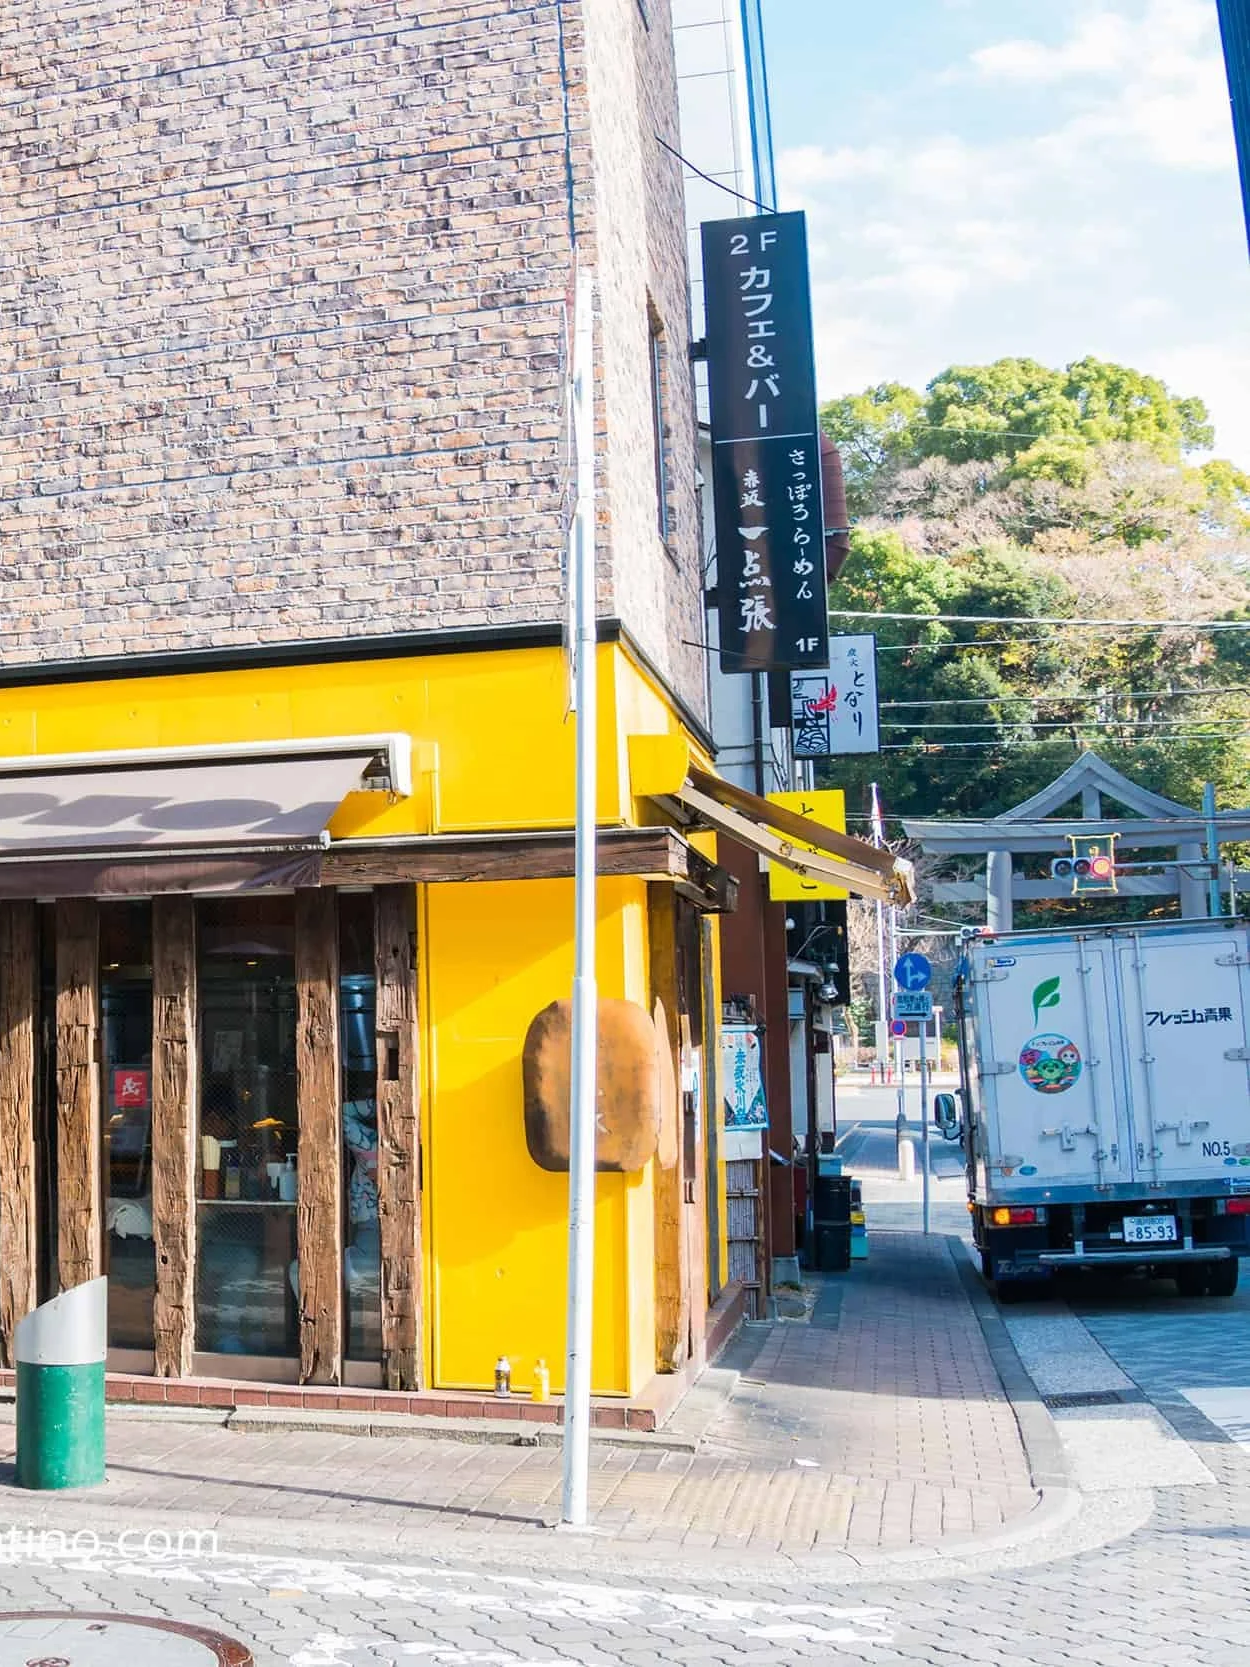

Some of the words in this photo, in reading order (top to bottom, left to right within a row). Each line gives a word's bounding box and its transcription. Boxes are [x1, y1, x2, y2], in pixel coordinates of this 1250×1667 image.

[729, 231, 778, 255] 2F
[738, 265, 781, 428] カフェ&バー
[788, 449, 814, 600] さっぽろらーめん
[795, 637, 819, 652] 1F
[844, 671, 866, 737] となり
[1145, 1006, 1232, 1026] フレッシュ青果
[1202, 1141, 1231, 1157] NO.5
[1135, 1225, 1175, 1240] 85-93
